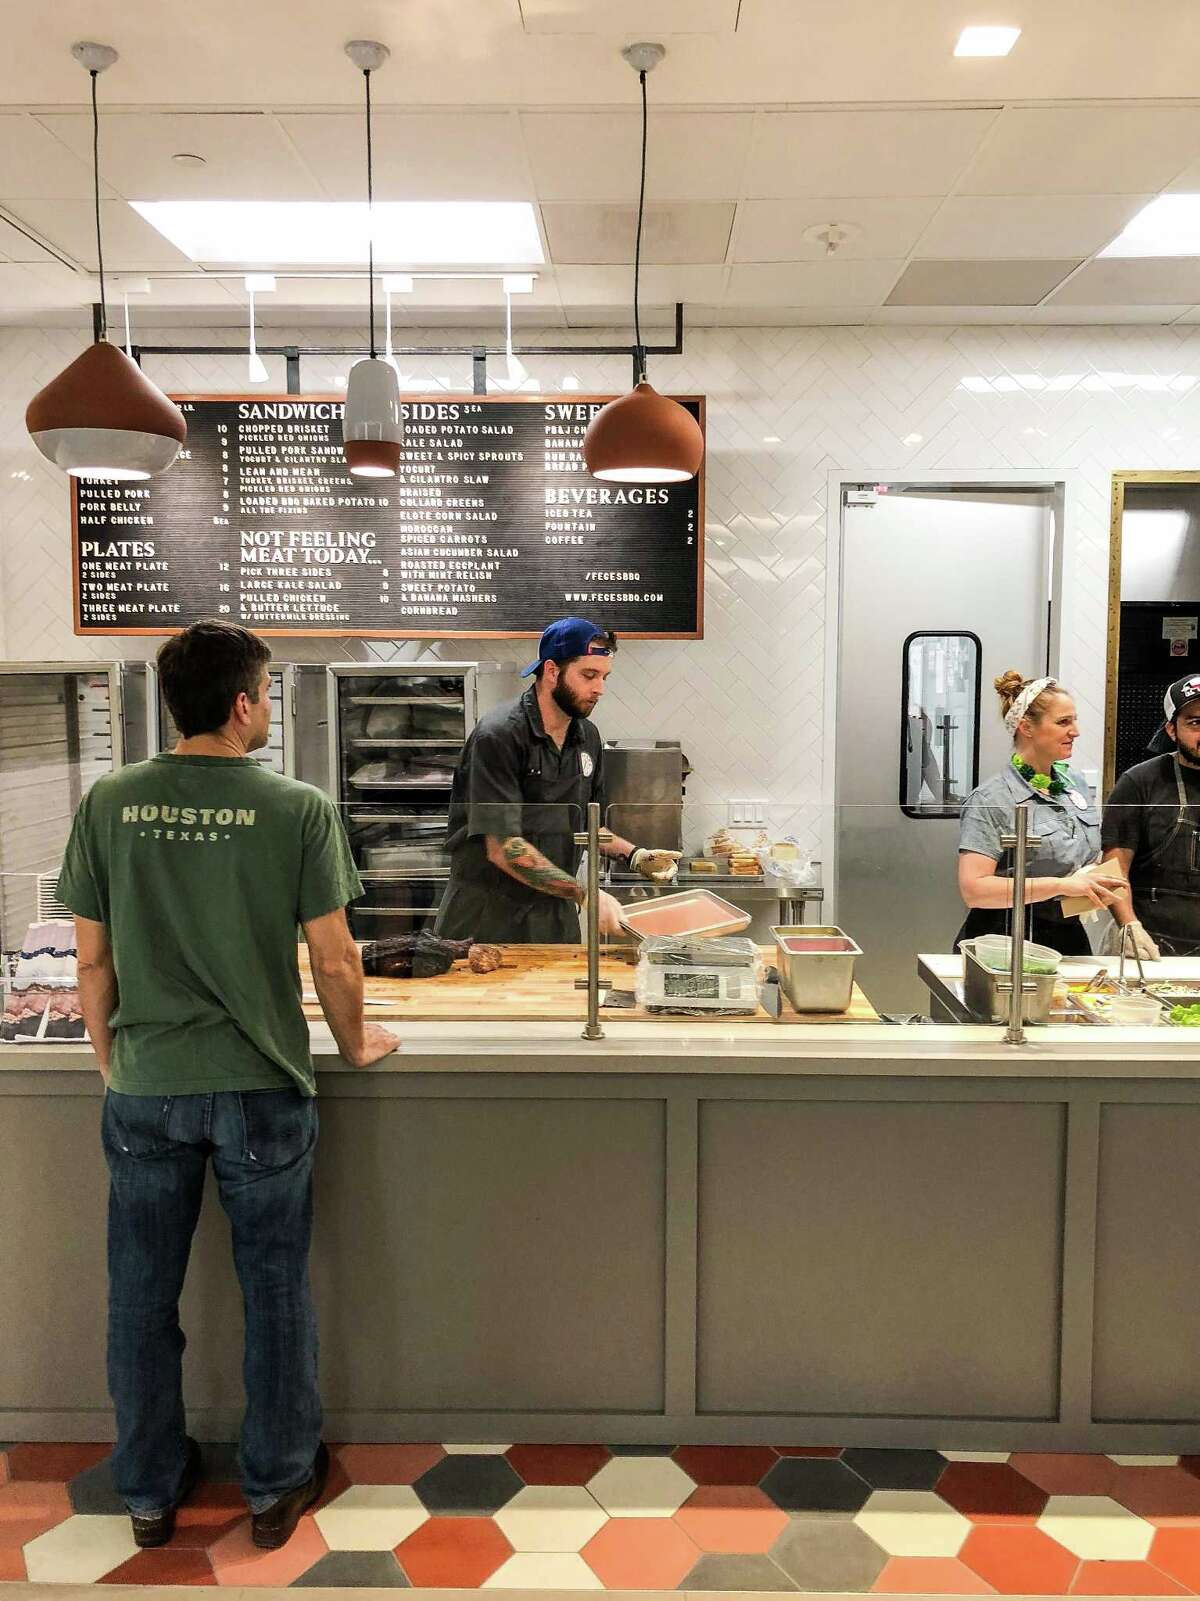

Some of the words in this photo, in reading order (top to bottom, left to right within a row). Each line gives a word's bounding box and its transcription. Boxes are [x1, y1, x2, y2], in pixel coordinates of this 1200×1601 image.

[401, 404, 459, 420] SIDES
[545, 405, 606, 421] SWEE
[217, 424, 228, 433] 10
[238, 425, 284, 433] CHOPPED
[288, 425, 329, 433] BRISKET
[405, 426, 437, 434] OADED
[441, 426, 478, 434] POTATO
[482, 426, 513, 434] SALAD
[430, 439, 463, 447] SALAD
[545, 439, 584, 448] BANANA
[240, 446, 276, 454] PULLED
[282, 446, 306, 454] PORK
[400, 452, 433, 460] SWEET
[448, 452, 474, 460] SPICY
[479, 452, 524, 461] SPROUTS
[545, 452, 565, 461] RUM
[545, 462, 578, 471] BREAD
[240, 468, 265, 476] LEAN
[270, 468, 288, 476] AND
[292, 468, 320, 476] MEAN
[222, 477, 228, 485] 7
[410, 476, 458, 484] CILANTRO
[464, 476, 489, 484] SLAW
[80, 489, 120, 498] PULLED
[124, 490, 150, 498] PORK
[400, 488, 442, 496] BRAISED
[545, 489, 669, 504] BEVERAGES
[303, 498, 335, 506] BAKED
[338, 498, 375, 506] POTATO
[379, 498, 388, 506] 10
[400, 499, 442, 507] COLLARD
[446, 499, 484, 507] GREENS
[80, 503, 106, 512] PORK
[110, 503, 141, 512] BELLY
[401, 512, 432, 520] ELOTE
[436, 512, 462, 520] CORN
[466, 512, 497, 520] SALAD
[545, 509, 568, 517] ICED
[572, 509, 592, 517] TEA
[688, 510, 693, 518] 2
[80, 516, 107, 524] HALF
[111, 516, 154, 525] CHICKEN
[401, 525, 453, 533] MOROCCAN
[545, 522, 596, 531] FOUNTAIN
[240, 531, 284, 546] NOT
[288, 532, 376, 547] FEELING
[401, 535, 436, 544] SPICED
[440, 535, 487, 544] CARROTS
[545, 536, 584, 544] COFFEE
[81, 542, 155, 557] PLATES
[401, 549, 430, 557] ASIAN
[433, 549, 483, 557] CUCUMBER
[487, 549, 518, 557] SALAD
[240, 548, 297, 563] MEAT
[82, 562, 101, 570] ONE
[105, 562, 130, 570] MEAT
[136, 562, 168, 570] PLATE
[219, 563, 229, 571] 12
[401, 561, 446, 569] ROASTED
[449, 562, 500, 570] EGGPLANT
[266, 568, 298, 576] THREE
[302, 568, 331, 576] SIDES
[401, 571, 424, 579] WITH
[428, 571, 452, 579] MINT
[456, 571, 492, 579] RELISH
[82, 583, 102, 591] TWO
[107, 583, 132, 591] MEAT
[137, 583, 169, 592] PLATE
[240, 581, 273, 589] LARGE
[277, 581, 304, 589] KALE
[401, 584, 433, 592] SWEET
[438, 584, 475, 592] POTATO
[240, 594, 279, 602] PULLED
[283, 594, 326, 602] CHICKEN
[402, 594, 408, 602] &
[411, 594, 448, 602] BANANA
[453, 594, 497, 602] MASHERS
[565, 594, 663, 602] WWW.FEGESBBQ.COM
[82, 604, 115, 612] THREE
[119, 604, 144, 612] MEAT
[149, 604, 180, 612] PLATE
[219, 605, 230, 613] 20
[251, 604, 289, 612] BUTTER
[293, 604, 339, 612] LETTUCE
[401, 607, 458, 615] CORNBREAD
[122, 804, 256, 825] HOUSTON
[153, 830, 217, 841] TEXAS
